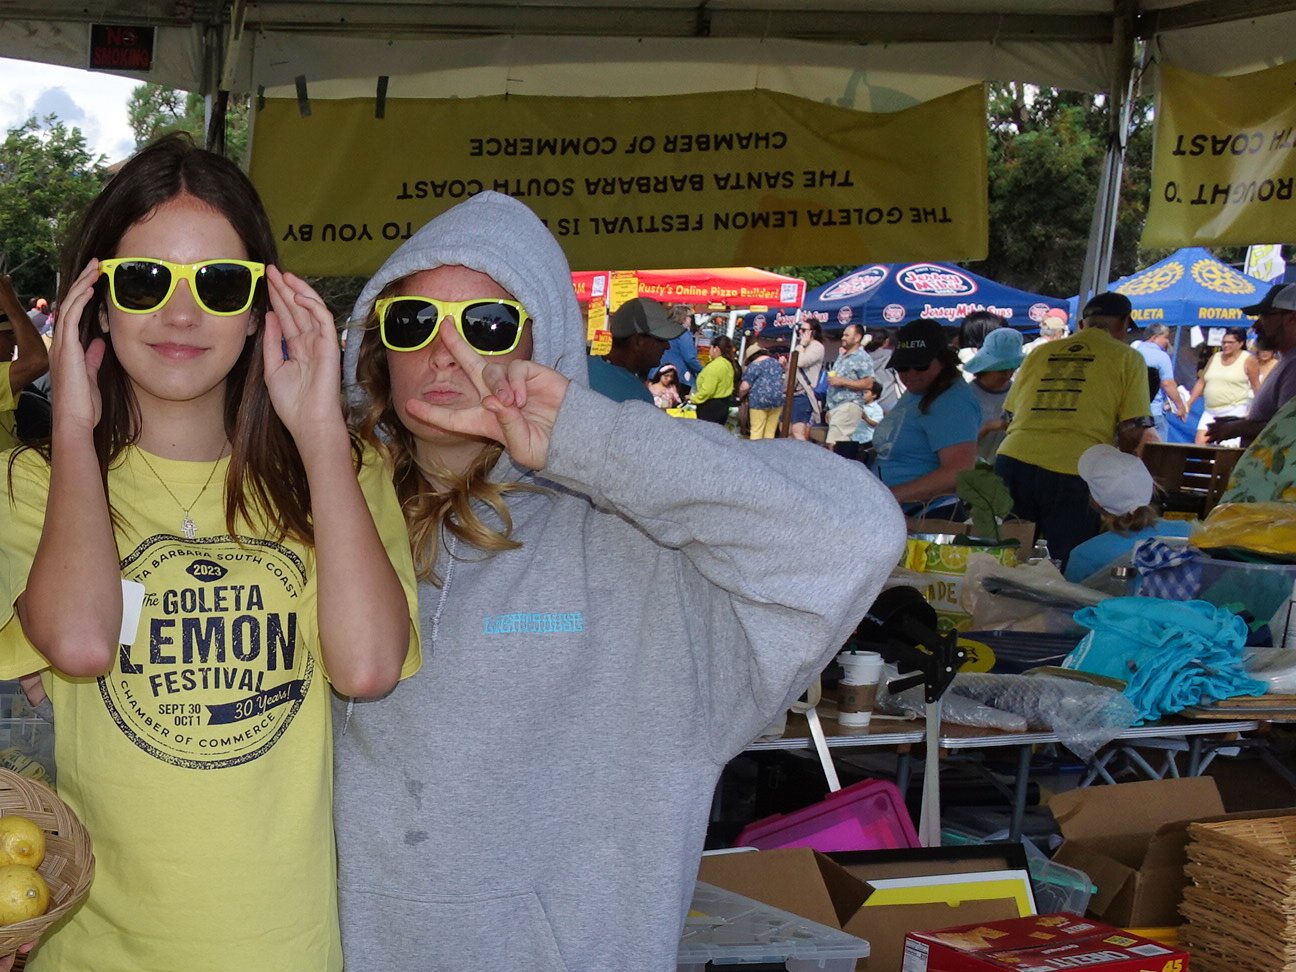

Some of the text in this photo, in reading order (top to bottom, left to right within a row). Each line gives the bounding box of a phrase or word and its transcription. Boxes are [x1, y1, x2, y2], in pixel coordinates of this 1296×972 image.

[106, 27, 138, 46] NO
[469, 131, 788, 157] CHAMBER OF COMMERCE
[1172, 131, 1265, 156] COAST
[397, 170, 854, 199] THE SANTA BARBARA SOUTH COAST
[590, 214, 704, 235] FESTIVAL
[713, 209, 798, 230] LEMON
[807, 207, 903, 227] GOLETA
[910, 207, 952, 224] THE
[283, 223, 313, 241] BY
[322, 223, 373, 242] YOU
[558, 217, 580, 235] IS
[905, 270, 962, 285] Jersey
[638, 282, 673, 297] Rusty's
[675, 284, 708, 297] Online
[920, 303, 955, 322] Jersey
[1131, 308, 1164, 320] OLETA
[1198, 307, 1242, 320] ROTARY
[151, 548, 298, 600] BARBARA SOUTH COAST
[193, 564, 222, 577] 2023
[162, 584, 265, 615] GOLETA
[119, 612, 298, 675] LEMON
[149, 667, 266, 698] FESTIVAL
[120, 680, 276, 749] CHAMBER OF COMMERCE
[158, 703, 202, 715] SEPT 30
[234, 701, 254, 720] 30
[174, 715, 194, 727] OCT
